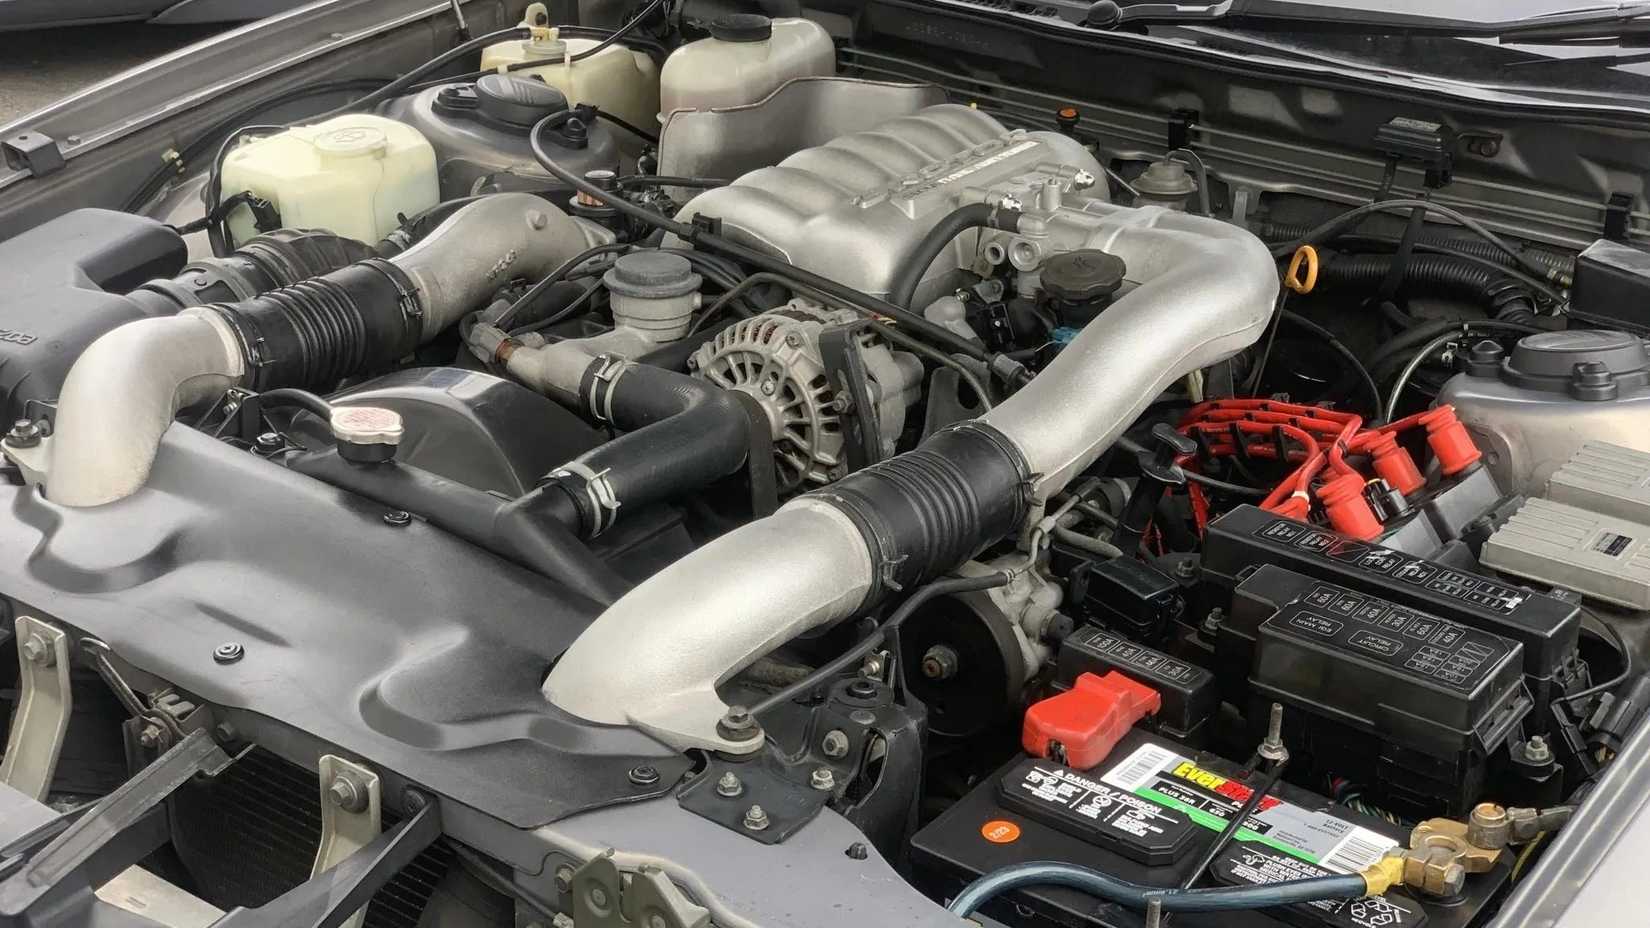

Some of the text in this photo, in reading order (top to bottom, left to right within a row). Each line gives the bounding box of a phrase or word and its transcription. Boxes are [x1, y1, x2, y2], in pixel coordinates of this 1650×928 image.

[1064, 773, 1111, 794] DANGER
[1119, 794, 1162, 814] POISON
[1159, 787, 1180, 798] PLUS
